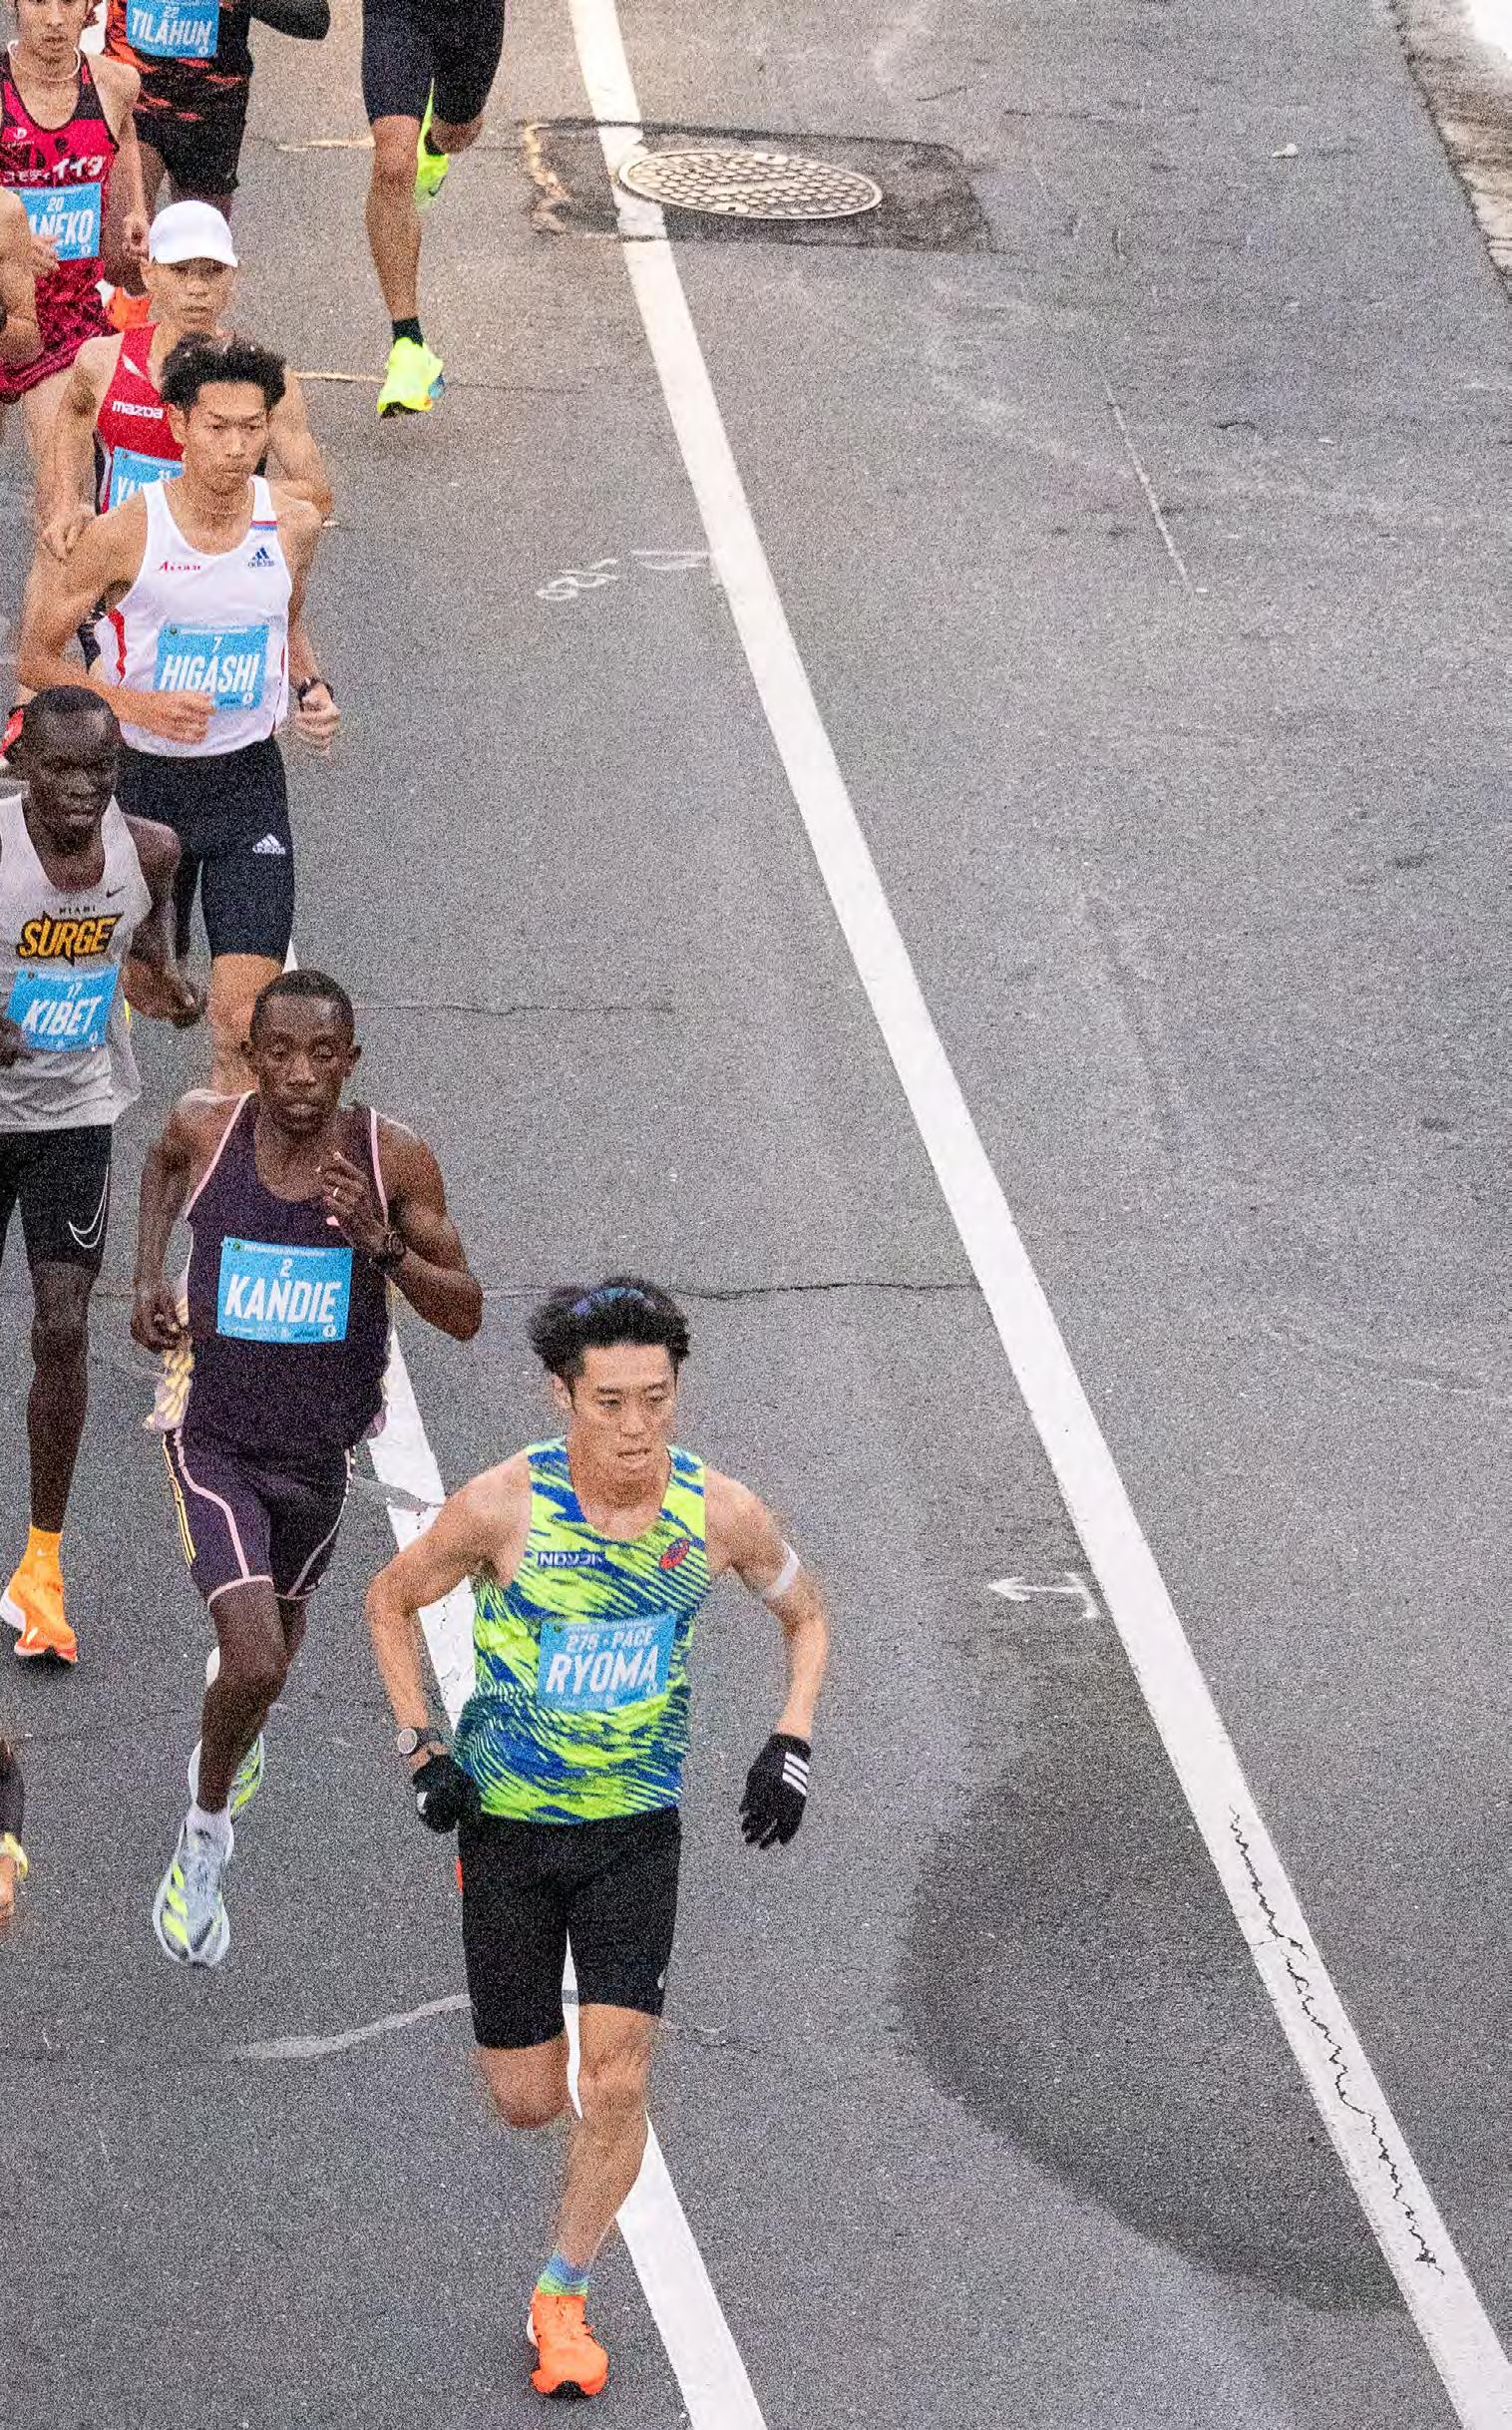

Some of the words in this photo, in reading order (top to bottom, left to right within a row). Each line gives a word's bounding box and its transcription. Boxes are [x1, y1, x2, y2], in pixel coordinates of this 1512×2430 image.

[132, 8, 212, 47] TILAHUN
[162, 6, 180, 19] 22
[47, 197, 65, 212] 20
[28, 209, 95, 246] ANEKO
[112, 401, 165, 419] mazda
[212, 636, 223, 653] 7
[159, 653, 260, 693] HIGASHI
[59, 904, 96, 915] MIAMI
[17, 913, 122, 963] SURGE
[21, 996, 103, 1036] KIBET
[279, 1258, 293, 1278] 2
[224, 1273, 343, 1324] KANDIE
[611, 1625, 656, 1649] PACE
[545, 1645, 658, 1695] RYOMA
